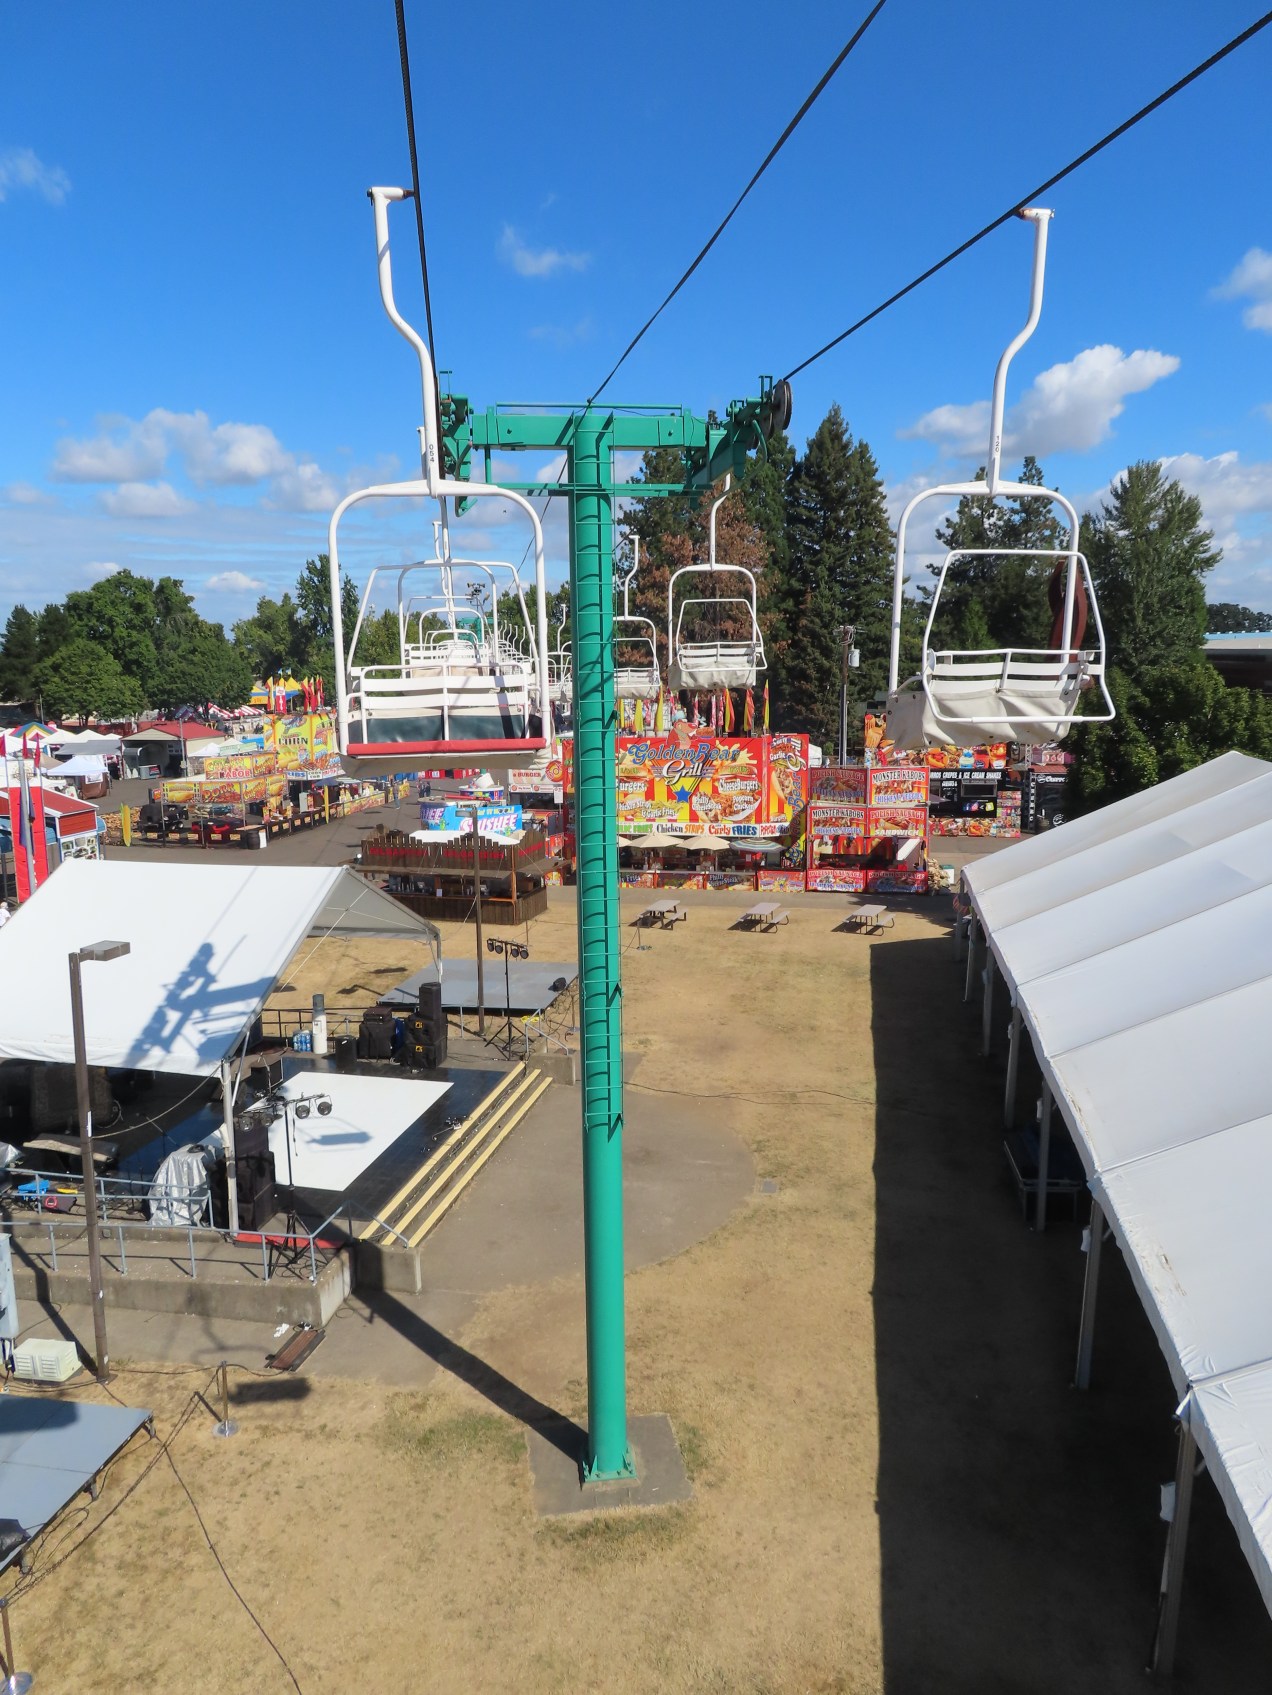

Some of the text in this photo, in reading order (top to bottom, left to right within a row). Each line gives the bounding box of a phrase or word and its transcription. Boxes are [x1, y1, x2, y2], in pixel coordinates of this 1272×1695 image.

[279, 737, 308, 746] CORN
[628, 743, 741, 765] Golden Bear
[665, 760, 703, 785] Grill
[873, 770, 925, 783] MONSTER KABOBS
[788, 771, 806, 808] Bear
[812, 809, 863, 818] MONSTER KABOBS
[871, 809, 924, 820] POLISH SAUSAGE
[459, 814, 518, 832] SUSHEE
[656, 823, 705, 834] Chicken STRIPS
[708, 823, 757, 837] Curly FRIES
